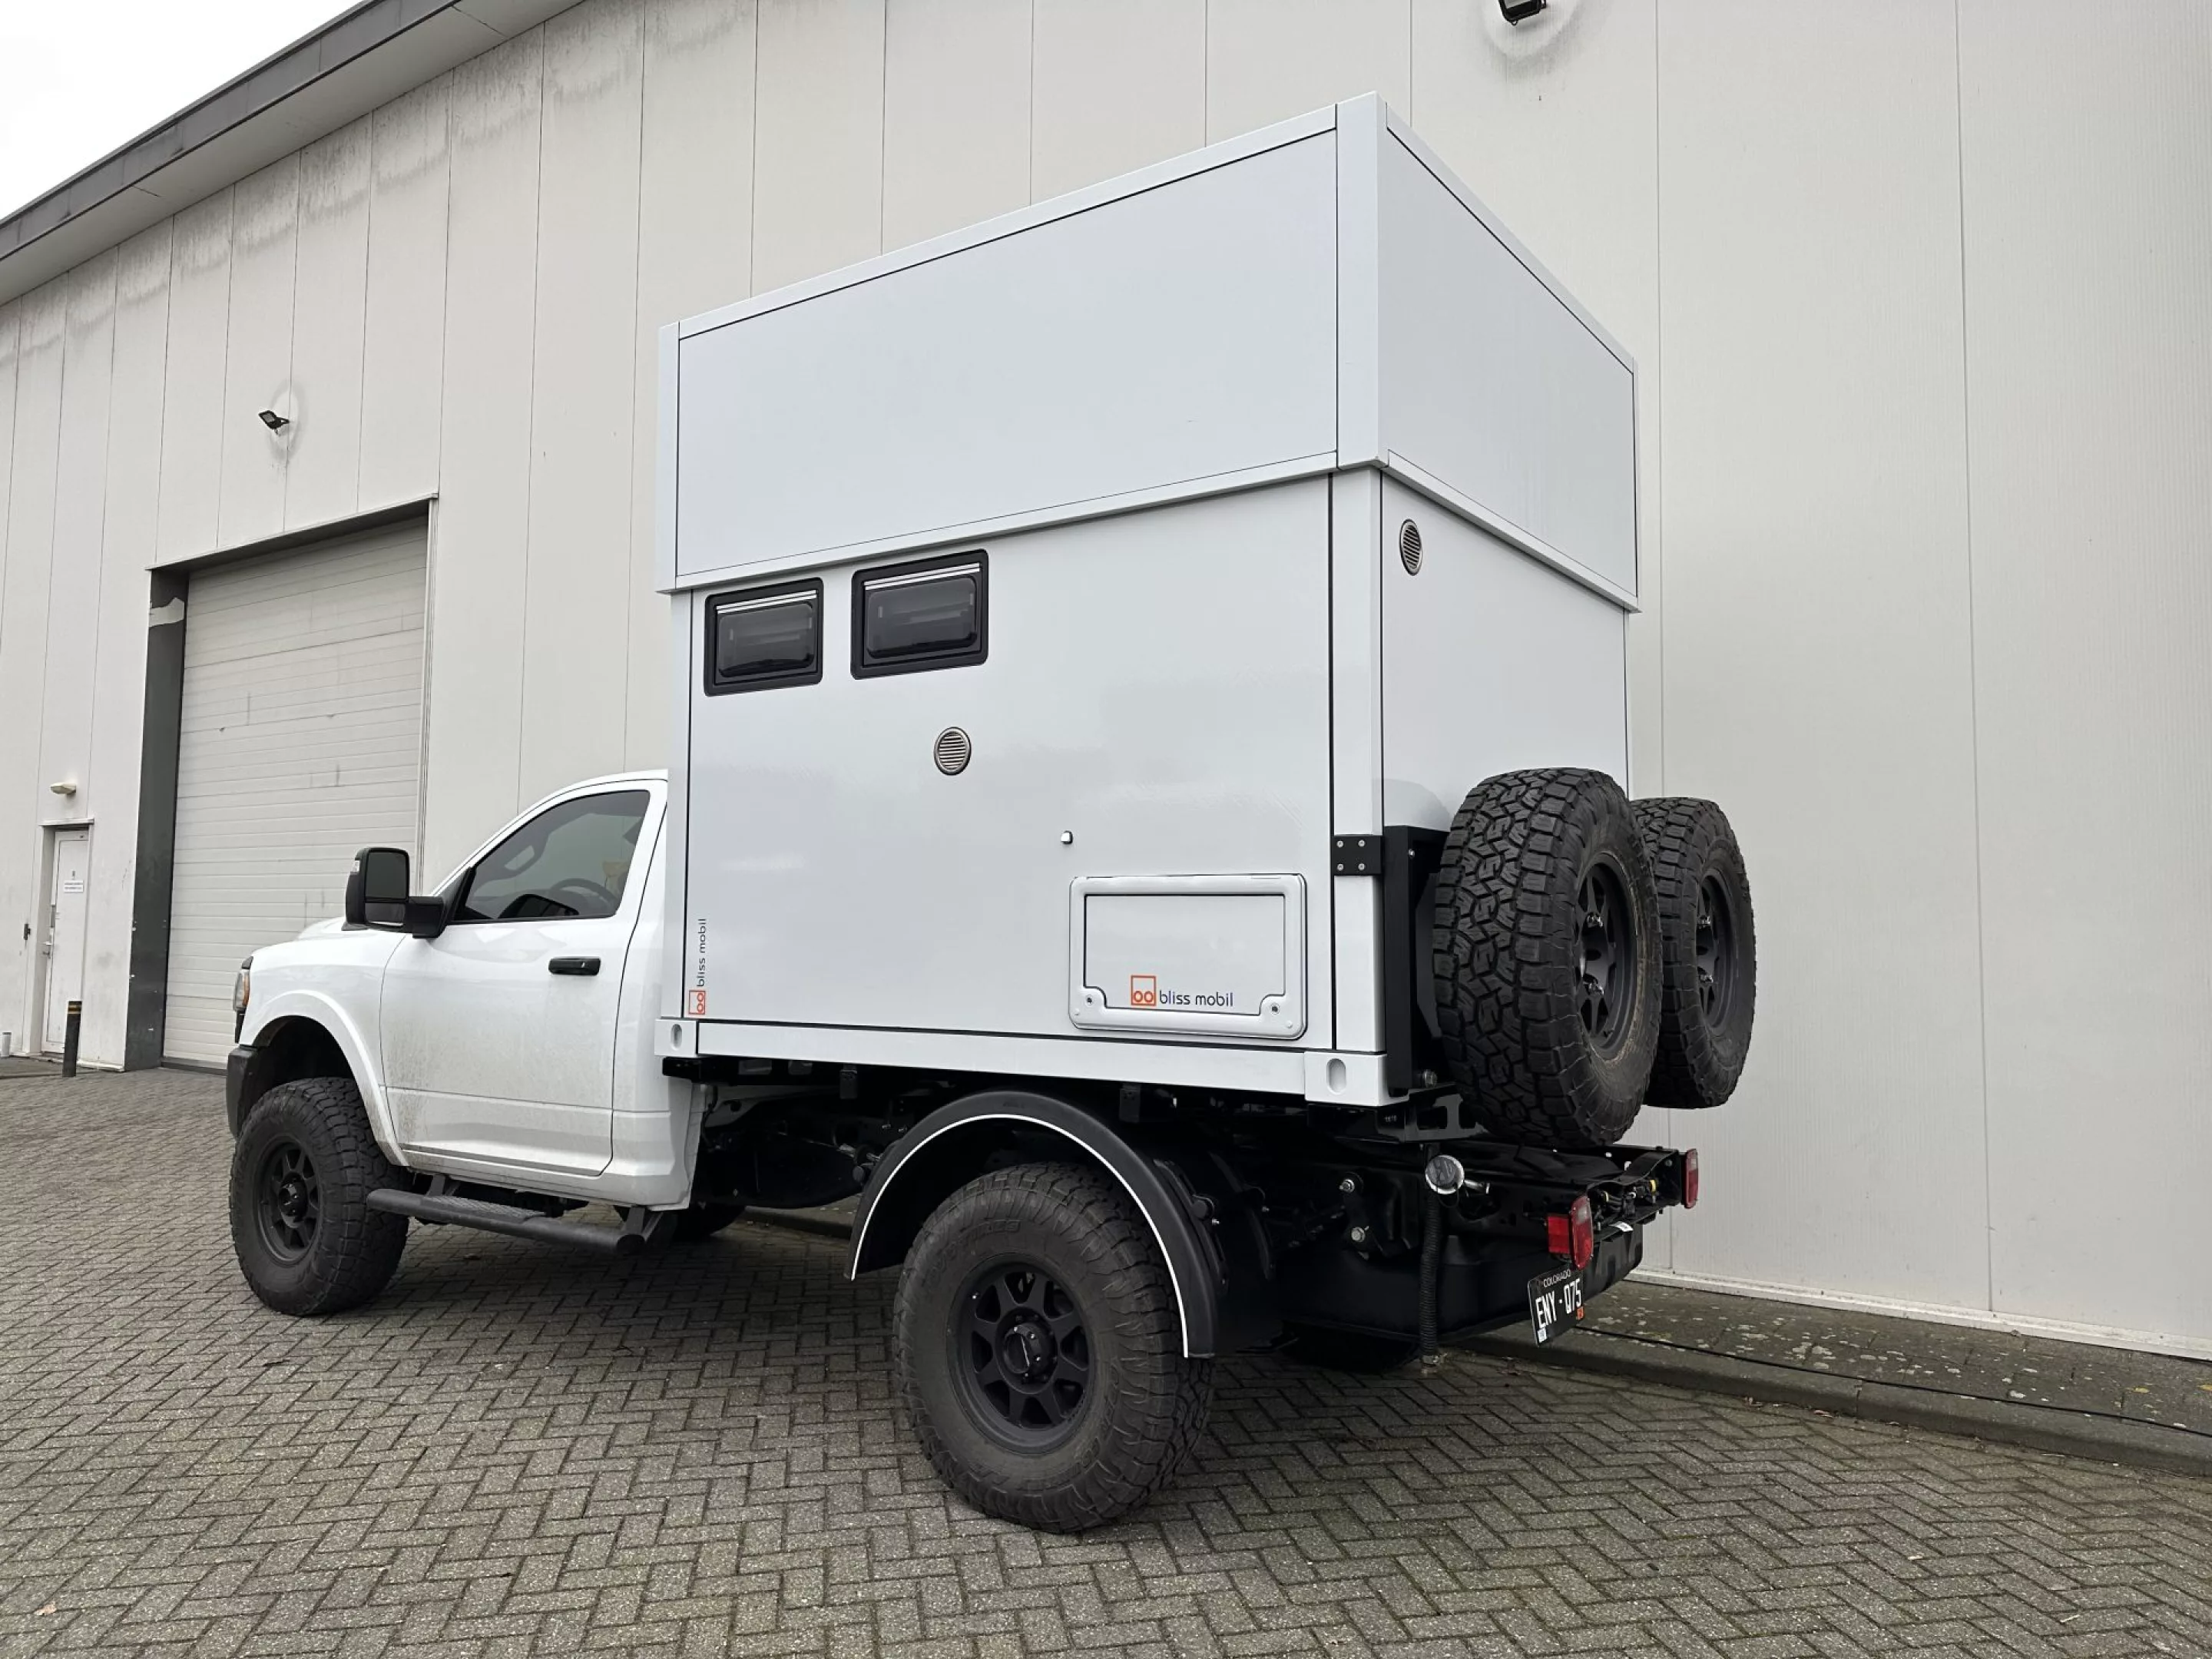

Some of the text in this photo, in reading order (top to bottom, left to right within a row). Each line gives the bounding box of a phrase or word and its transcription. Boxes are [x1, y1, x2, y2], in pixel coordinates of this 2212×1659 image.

[696, 919, 707, 987] bliss mobil
[1159, 989, 1233, 1007] bliss mobil
[1543, 1269, 1571, 1287] COLORADO
